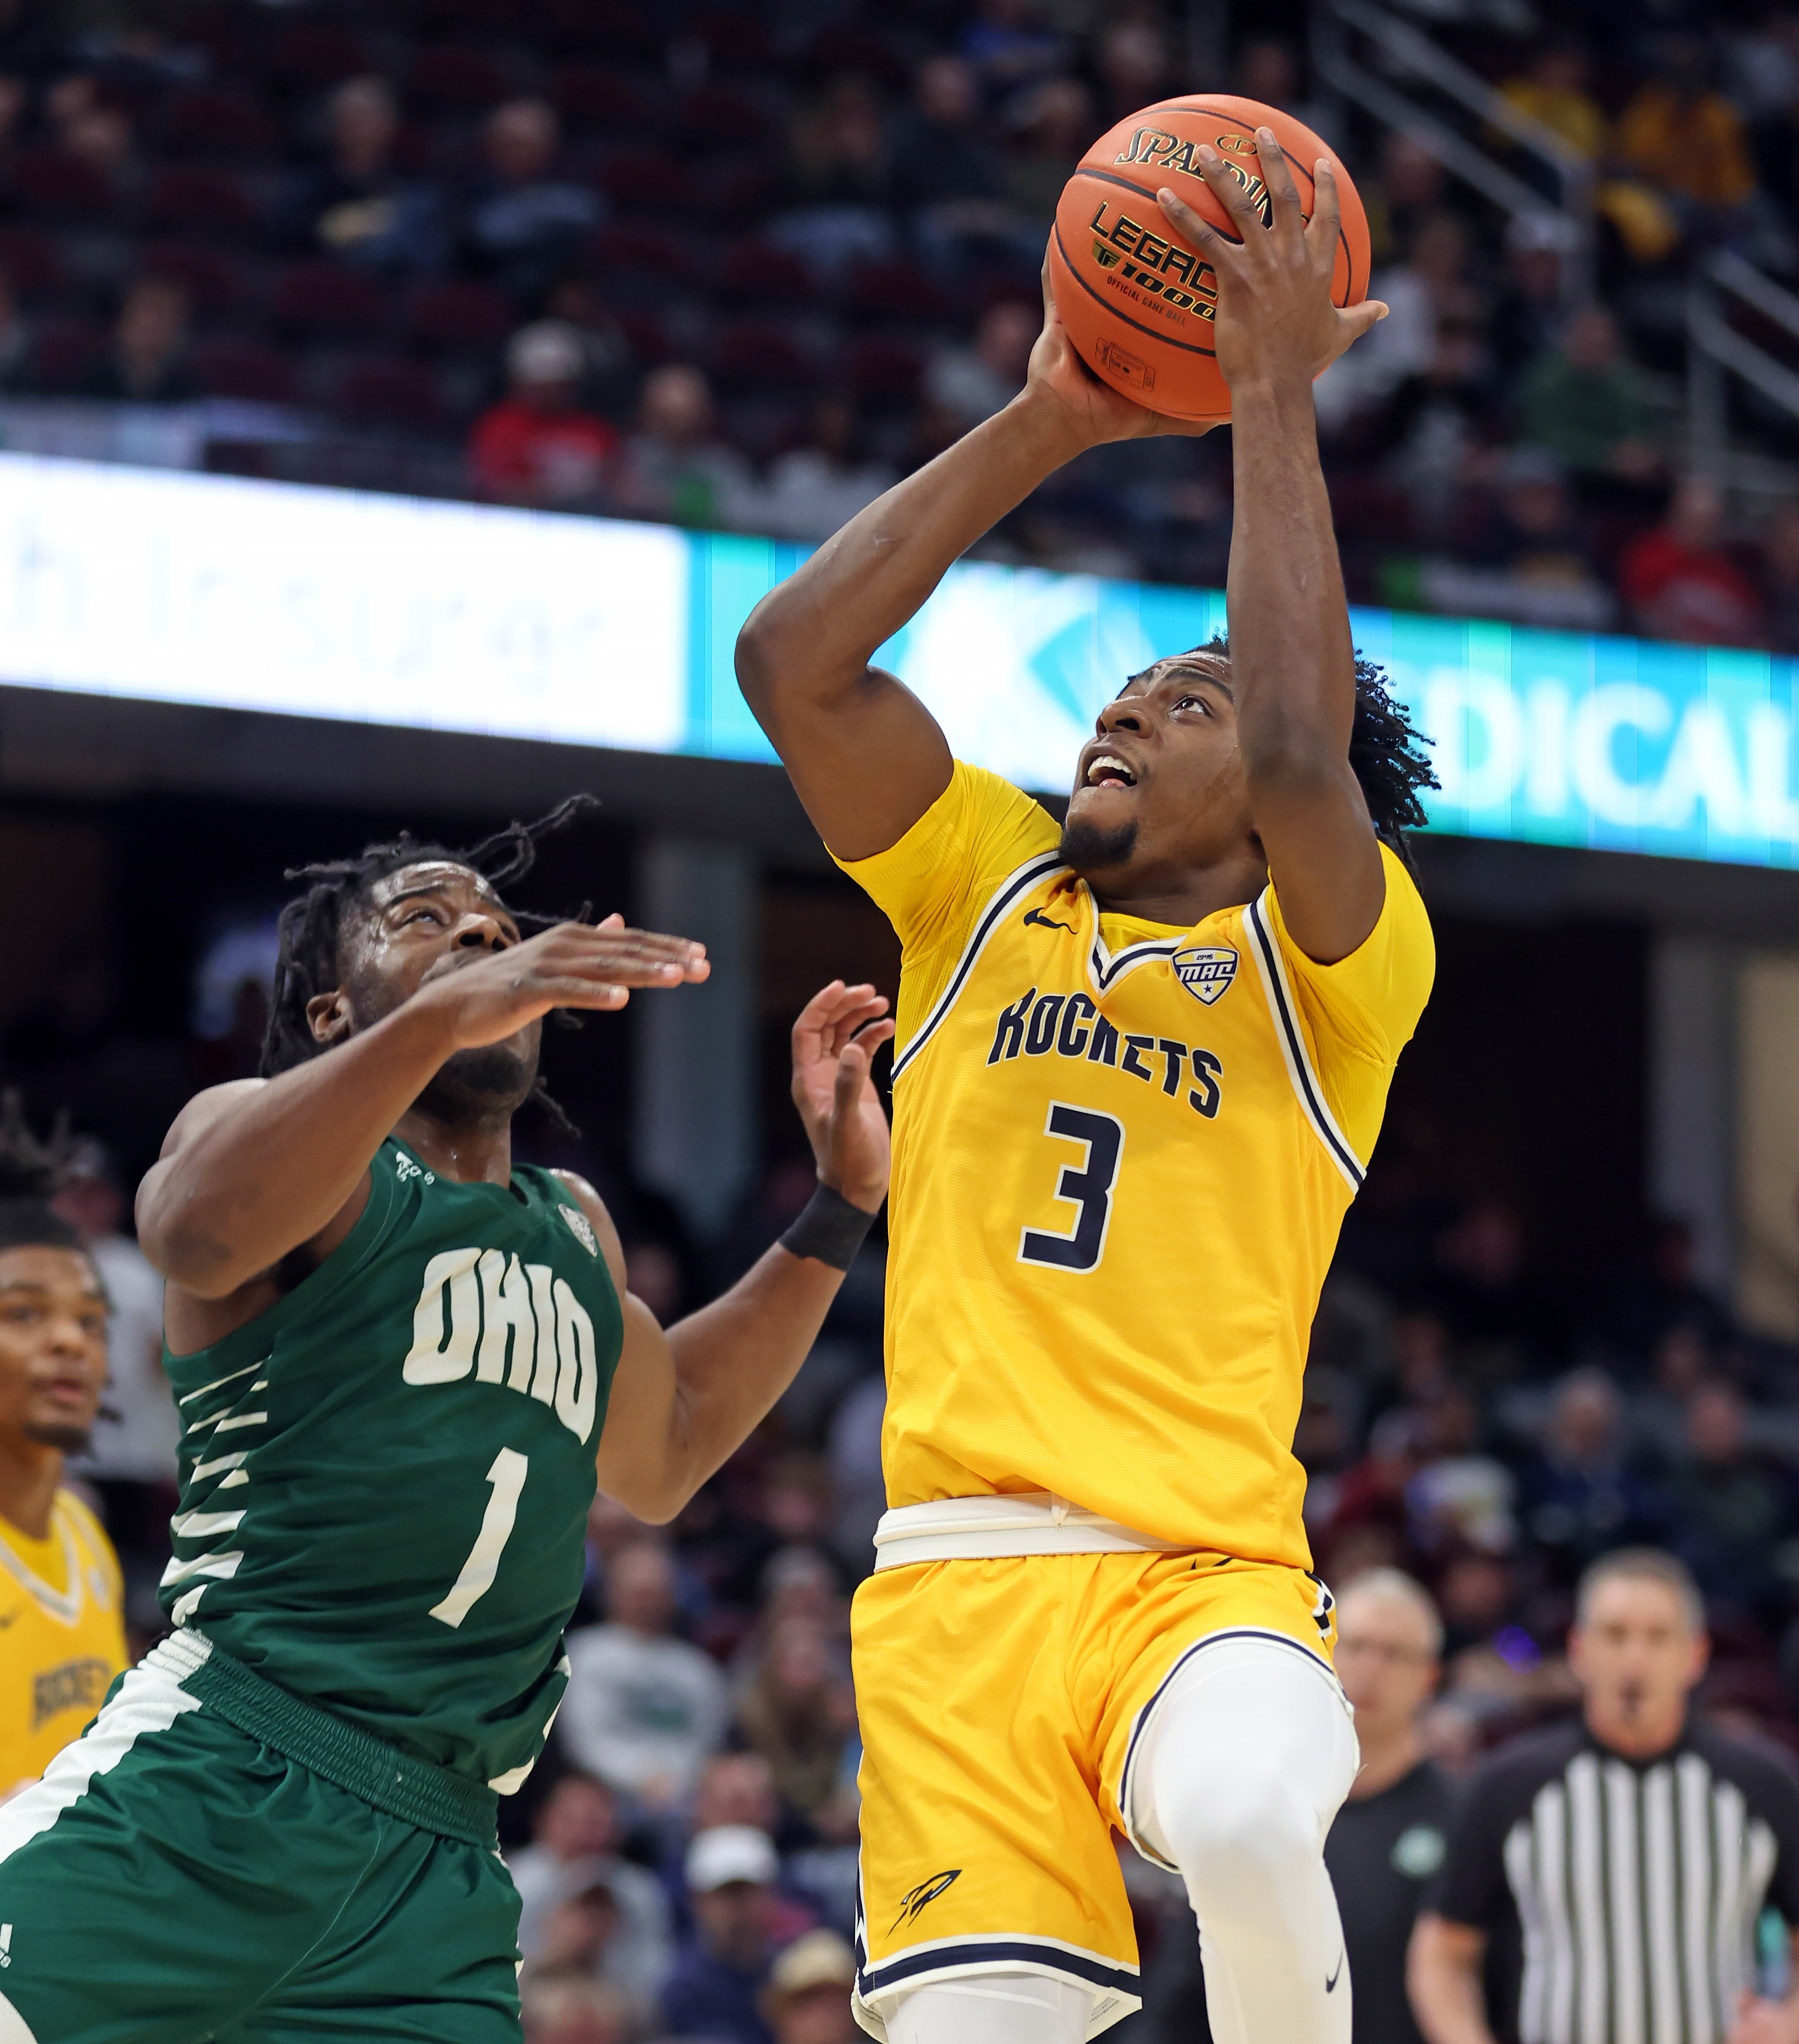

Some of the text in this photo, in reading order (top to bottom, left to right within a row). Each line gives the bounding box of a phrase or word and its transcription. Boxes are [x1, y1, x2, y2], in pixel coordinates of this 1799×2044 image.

[1114, 126, 1276, 231] SPADIN
[1089, 201, 1218, 300] LEGAC
[1107, 276, 1186, 326] OFFICIAL GAME BALL
[1121, 262, 1218, 323] 1000
[1405, 662, 1799, 842] DICAL
[1179, 963, 1236, 982] MAC
[986, 986, 1224, 1120] ROCKETS
[1016, 1100, 1126, 1275] 3
[402, 1247, 598, 1445] OHIO
[428, 1447, 528, 1629] 1
